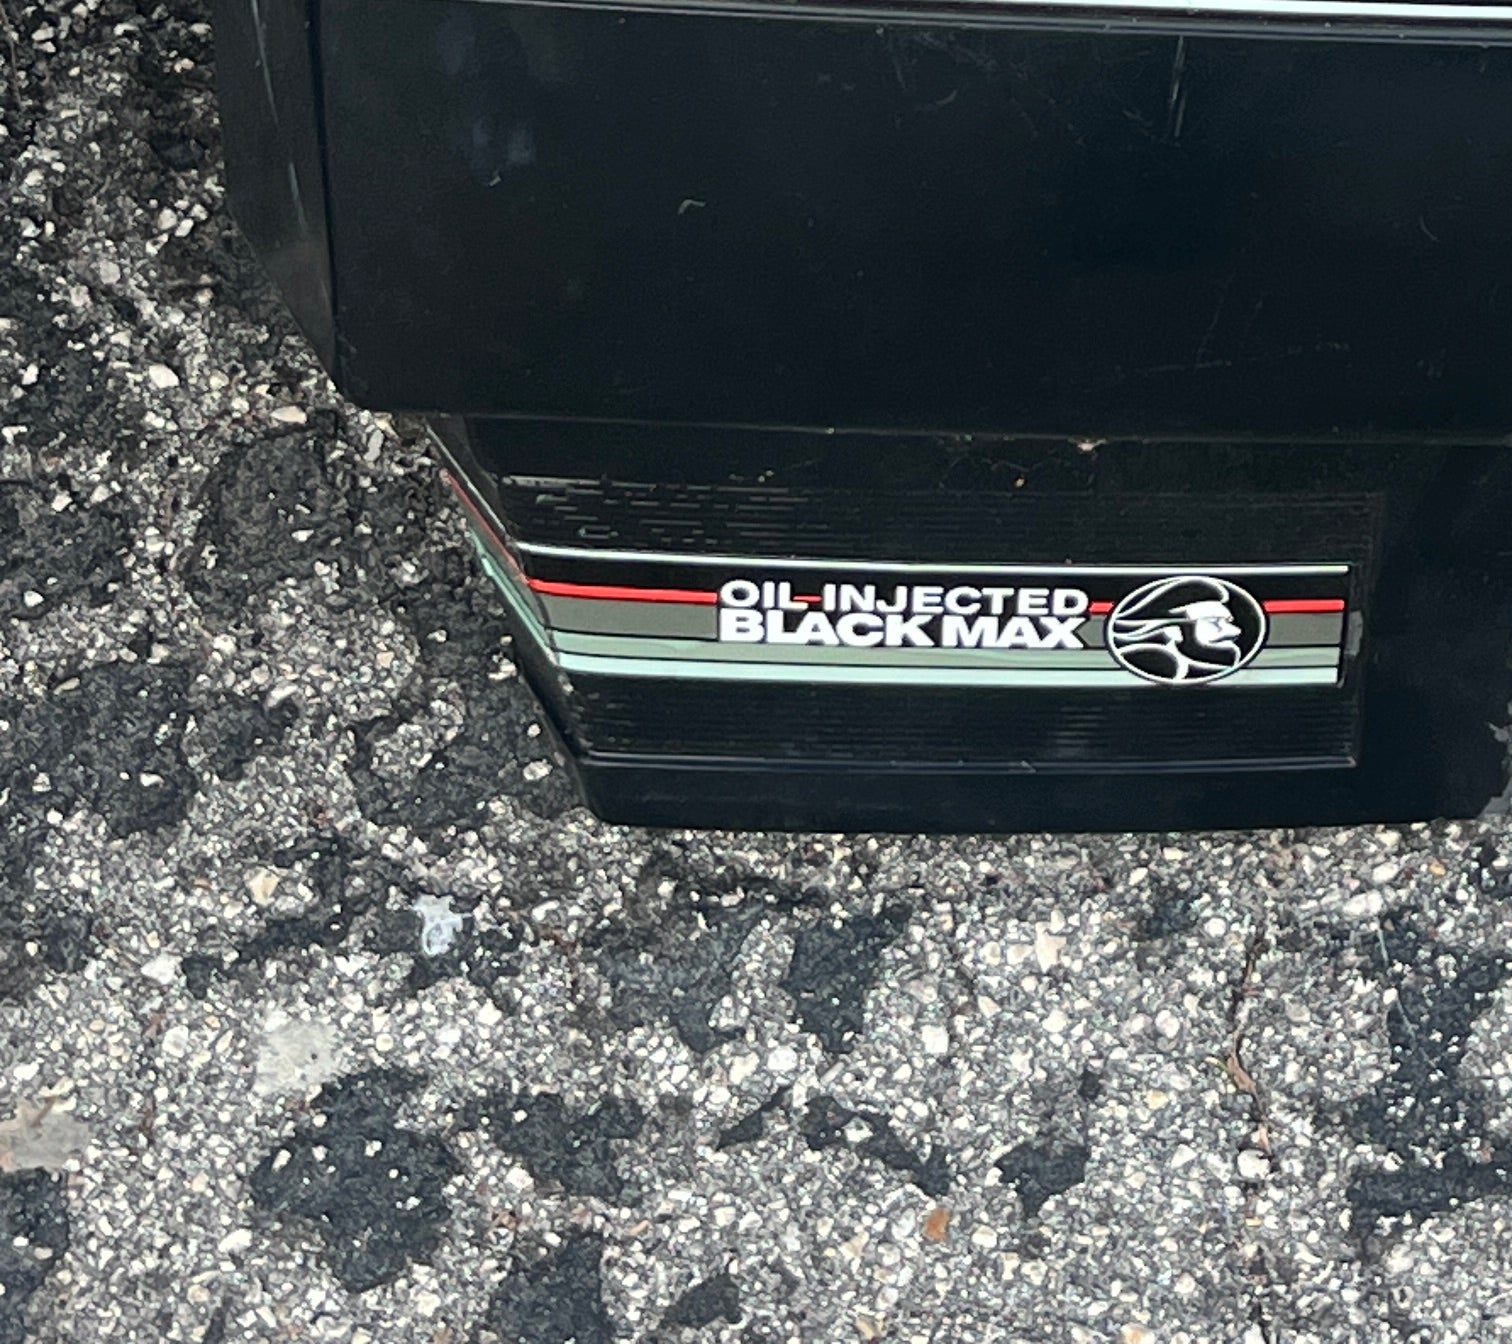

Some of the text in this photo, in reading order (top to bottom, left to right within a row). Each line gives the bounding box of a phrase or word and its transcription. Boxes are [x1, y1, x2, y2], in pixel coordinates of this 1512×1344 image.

[719, 578, 1089, 616] OIL INJECTED
[718, 607, 1087, 650] BLACK MAX
